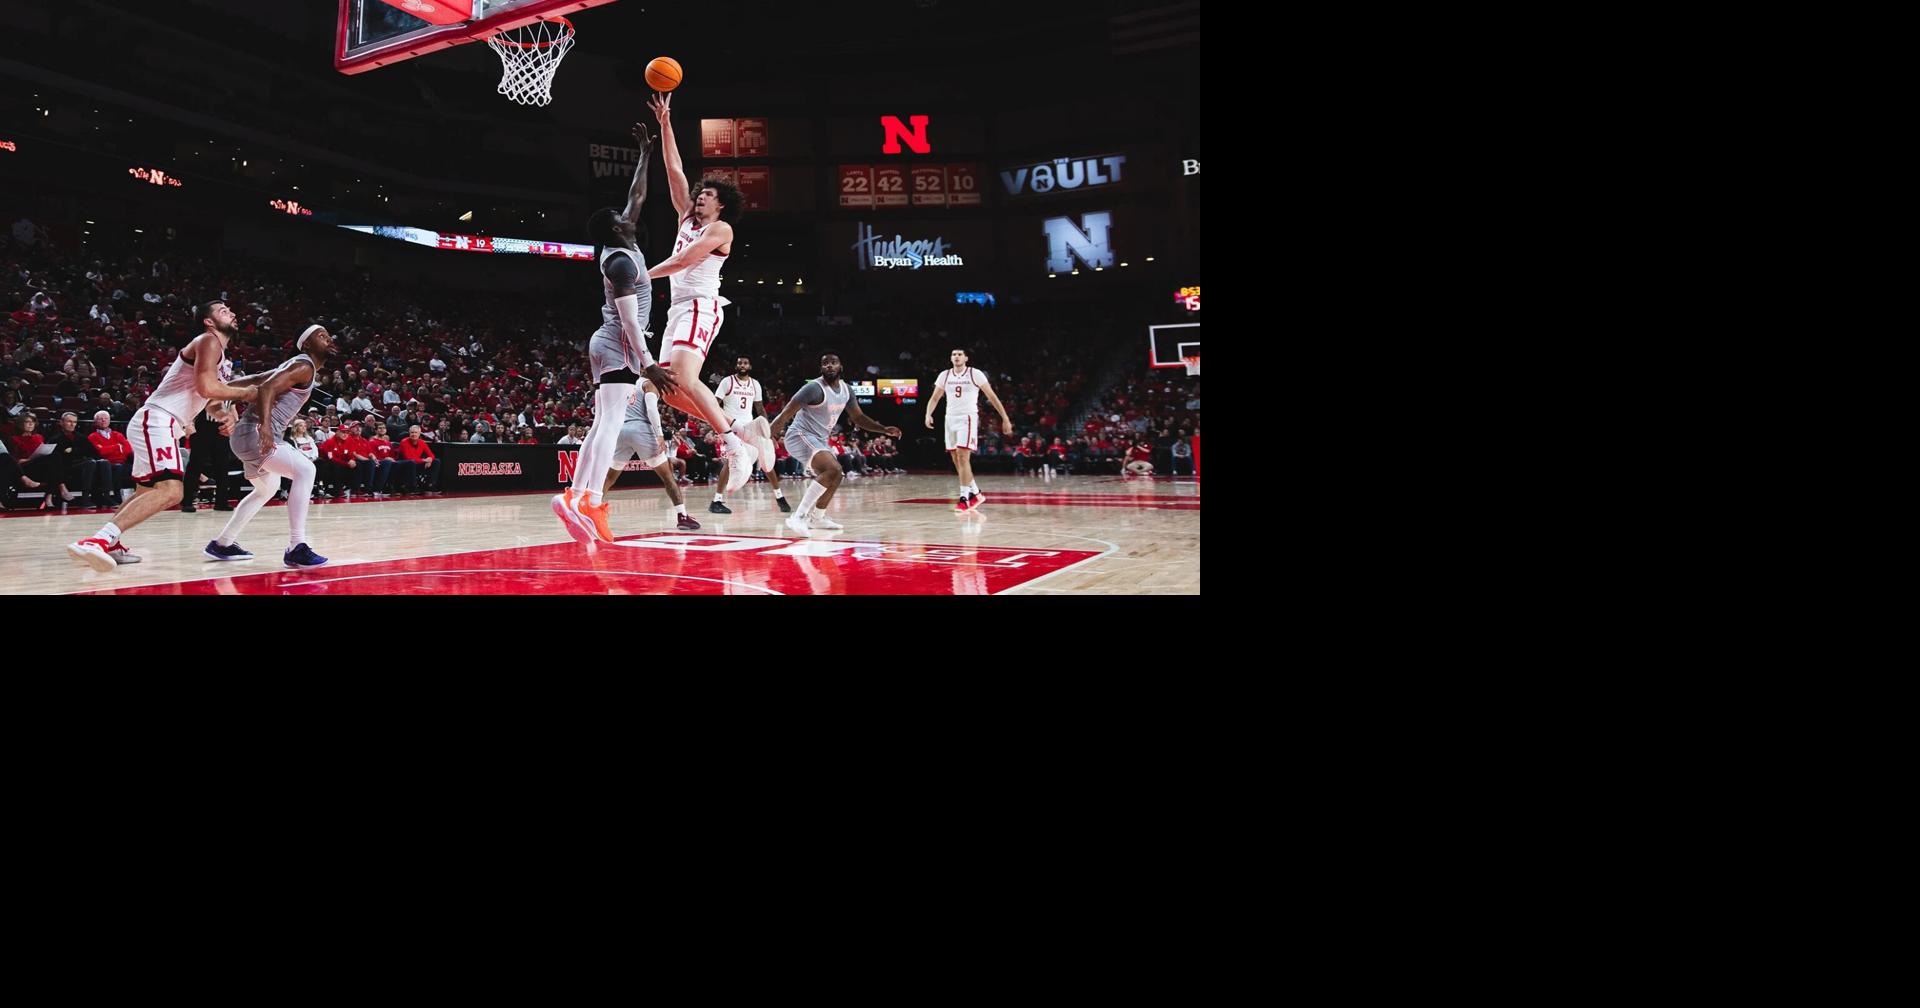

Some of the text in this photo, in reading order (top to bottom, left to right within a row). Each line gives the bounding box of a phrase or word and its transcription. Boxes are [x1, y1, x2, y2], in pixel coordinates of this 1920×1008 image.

[880, 115, 931, 154] N
[589, 143, 640, 161] BETTE
[592, 160, 634, 178] WIT
[842, 177, 868, 193] 22
[877, 177, 904, 192] 42
[914, 176, 941, 191] 52
[953, 176, 974, 191] 10
[475, 239, 486, 248] 19
[1043, 211, 1114, 272] N
[874, 254, 963, 269] Bryan Health
[698, 327, 709, 343] N
[955, 386, 962, 398] 9
[740, 397, 747, 409] 3
[156, 447, 173, 462] N
[457, 462, 522, 476] NEBRASKA
[558, 450, 580, 483] N
